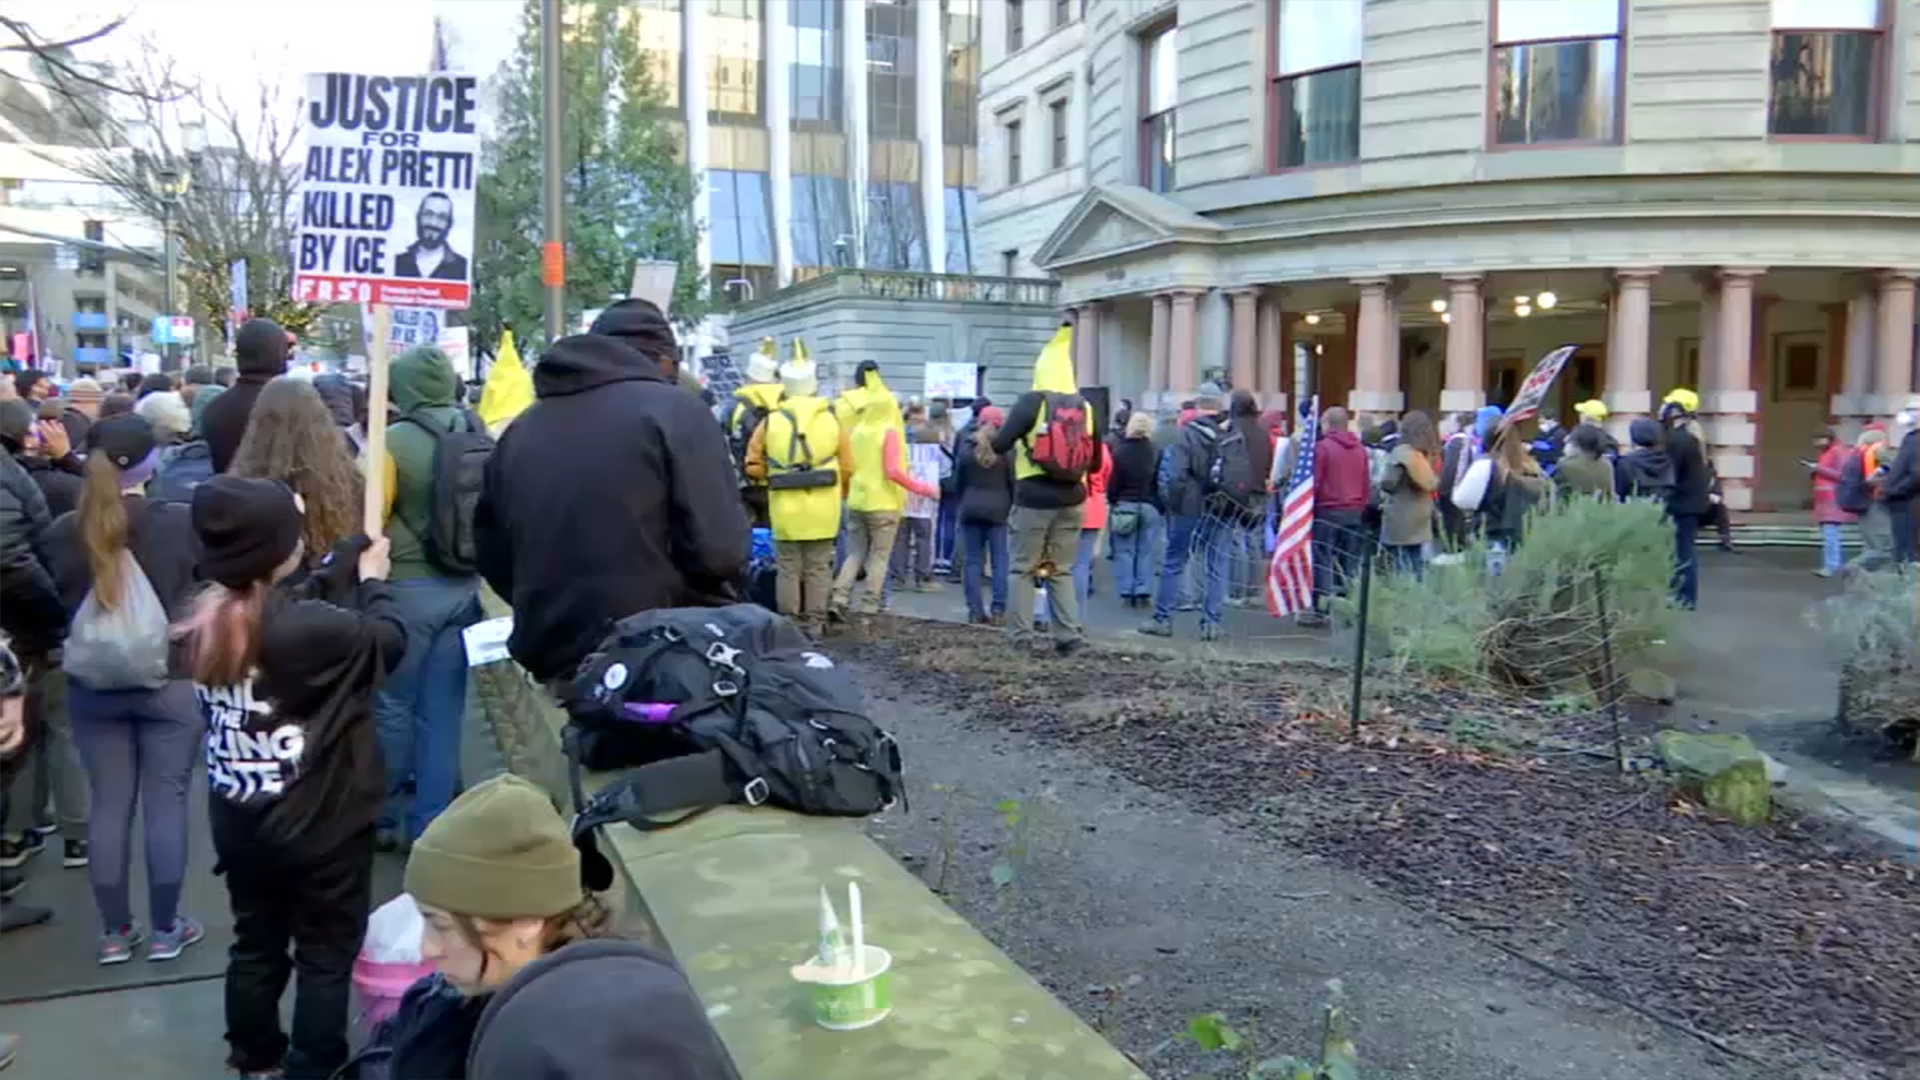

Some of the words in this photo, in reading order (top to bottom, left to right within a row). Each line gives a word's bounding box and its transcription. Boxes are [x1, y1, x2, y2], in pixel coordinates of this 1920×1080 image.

[309, 73, 476, 133] JUSTICE
[362, 132, 420, 147] FOR
[304, 146, 372, 185] ALEX
[381, 150, 473, 190] PRETTI
[302, 191, 394, 231] KILLED
[299, 234, 336, 272] BY
[344, 236, 386, 274] ICE
[210, 705, 243, 730] THE
